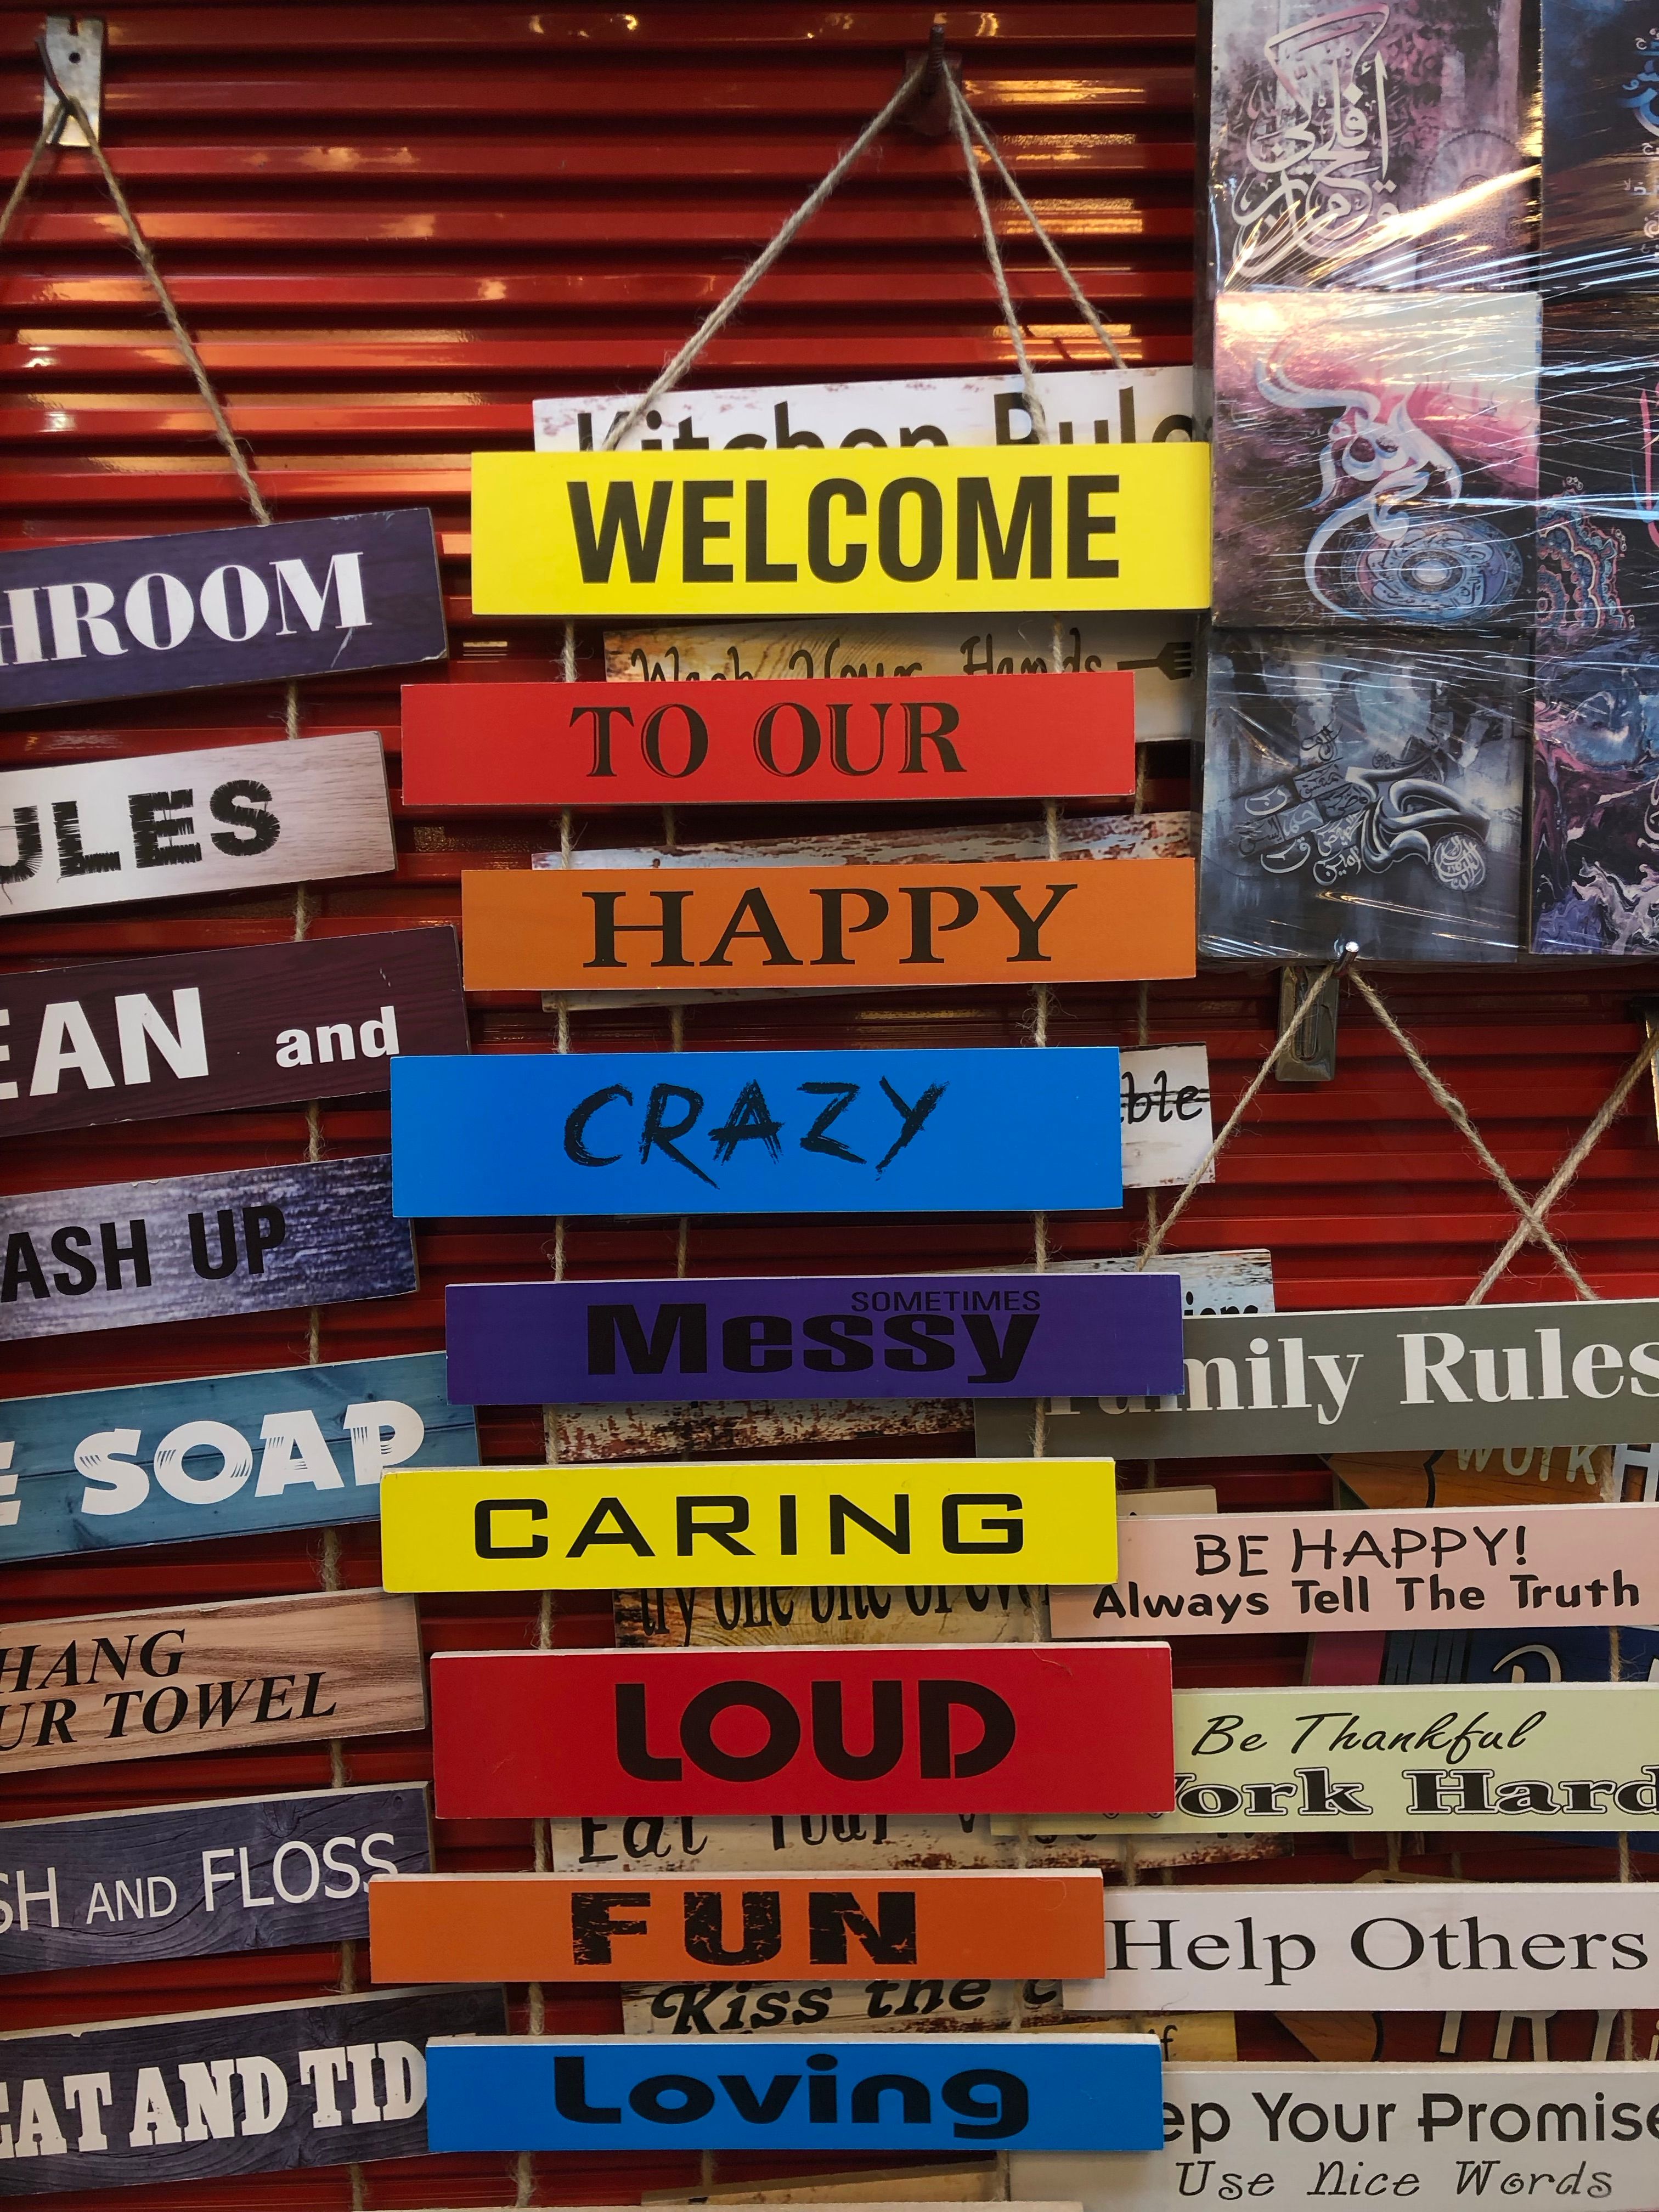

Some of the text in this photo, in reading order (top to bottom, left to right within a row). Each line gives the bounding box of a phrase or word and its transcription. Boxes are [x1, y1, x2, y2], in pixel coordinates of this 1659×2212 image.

[566, 475, 1119, 584] WELCOME
[569, 702, 967, 778] TO OUR
[582, 884, 1077, 968] HAPPY
[275, 1006, 400, 1068] and
[564, 1075, 950, 1189] CRAZY
[1121, 1070, 1204, 1125] ble
[1, 1206, 286, 1302] ASH UP
[851, 1290, 1041, 1312] SOMETIMES
[587, 1302, 1041, 1384] Messy
[1396, 1328, 1659, 1404] Rules
[74, 1400, 425, 1516] SOAP
[475, 1493, 1024, 1559] CARING
[1193, 1525, 1527, 1576] BE HAPPY!
[1092, 1581, 1269, 1624] Always
[1292, 1575, 1369, 1615] Tell
[1396, 1573, 1485, 1611] The
[1510, 1570, 1639, 1609] Truth
[0, 1628, 185, 1693] HANG
[104, 1671, 337, 1739] TOWEL
[615, 1680, 1016, 1782] LOUD
[1192, 1711, 1547, 1764] Be Thankful
[1402, 1765, 1659, 1815] Hard
[86, 1876, 177, 1925] AND
[202, 1833, 398, 1912] FLOSS
[571, 1892, 917, 1965] FUN
[1104, 1916, 1649, 1985] Help Others
[651, 1979, 833, 2034] Kiss
[129, 2056, 289, 2147] AND
[299, 2040, 427, 2128] TID
[554, 2053, 1029, 2140] Loving
[1251, 2092, 1397, 2142] Your
[1176, 2160, 1274, 2200] Use
[1455, 2160, 1613, 2198] Words
